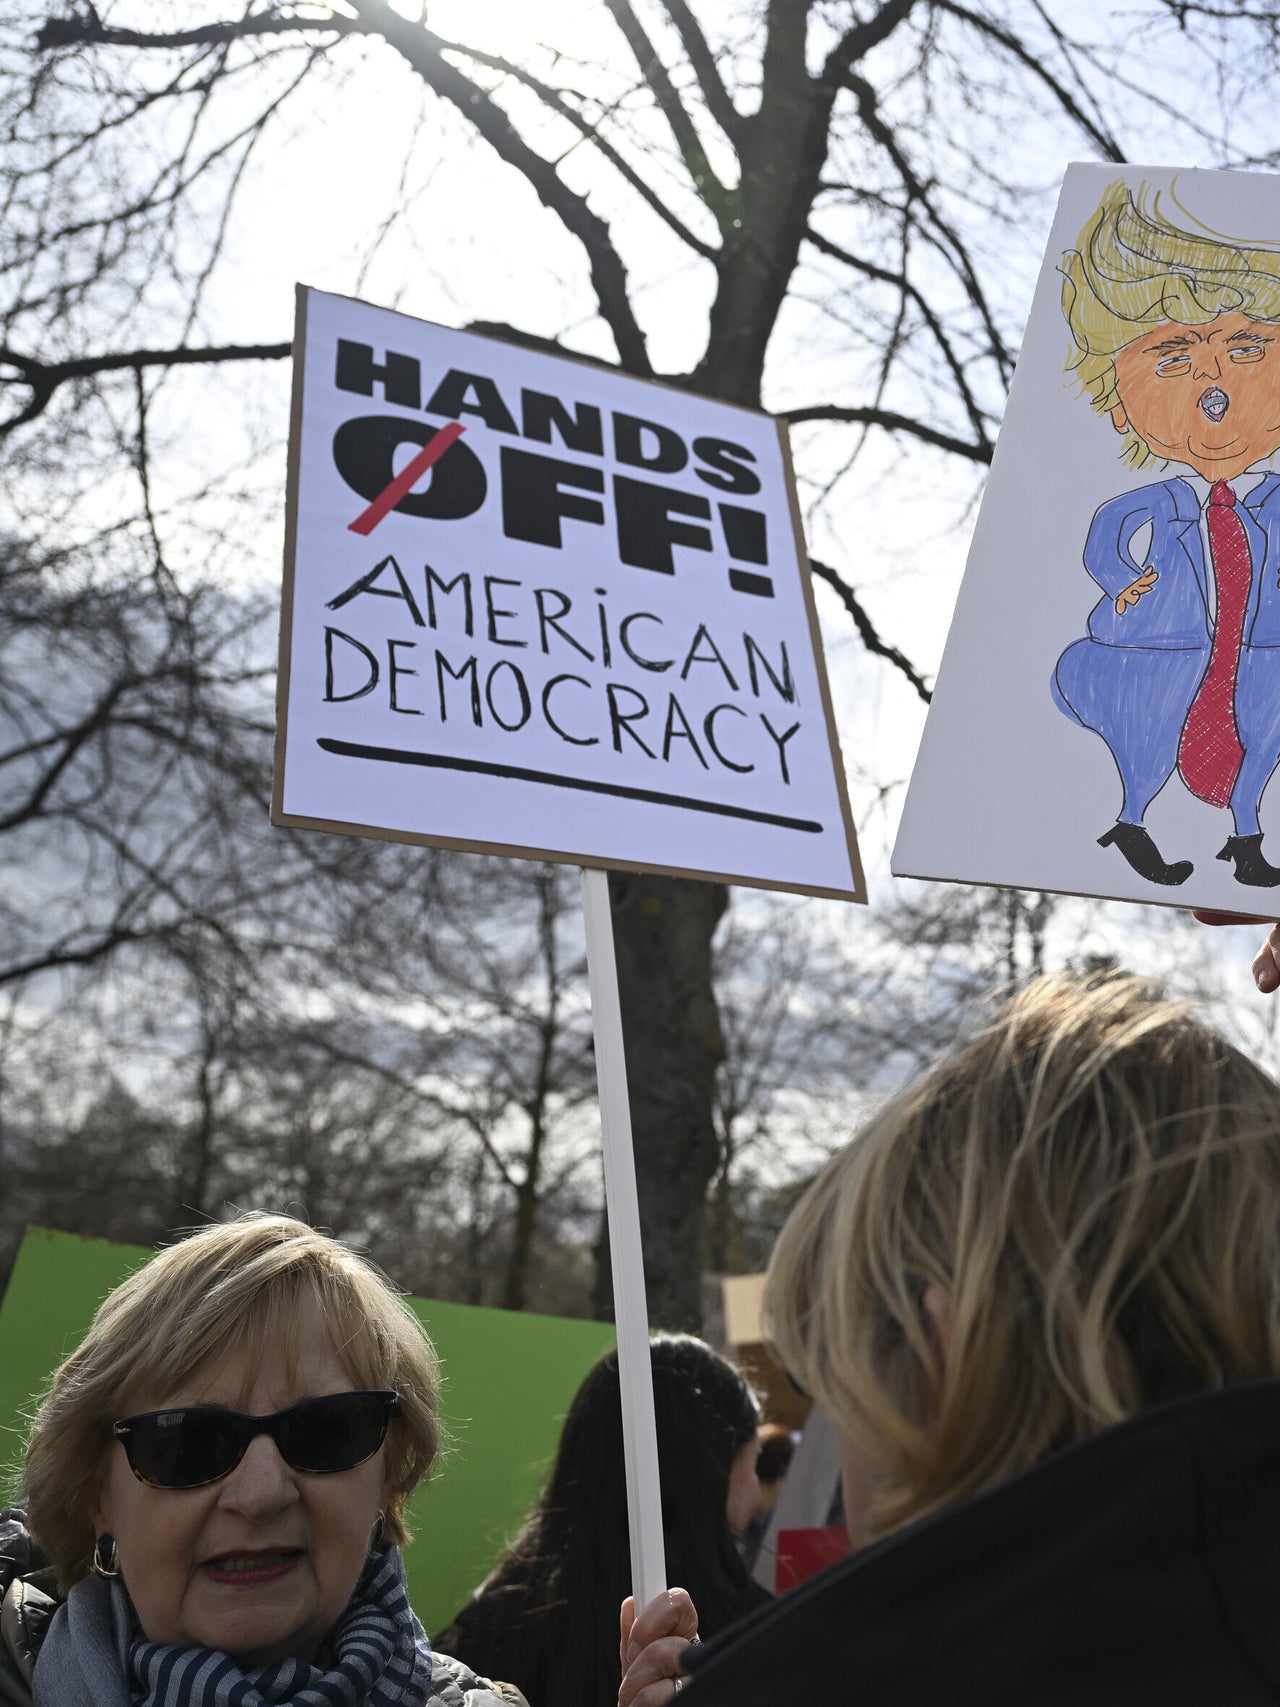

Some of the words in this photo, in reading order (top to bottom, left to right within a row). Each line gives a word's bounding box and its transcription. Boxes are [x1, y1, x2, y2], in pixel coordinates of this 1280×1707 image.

[335, 338, 761, 495] HANDS
[333, 415, 775, 598] OFF!
[322, 626, 801, 784] DEMOCRACY
